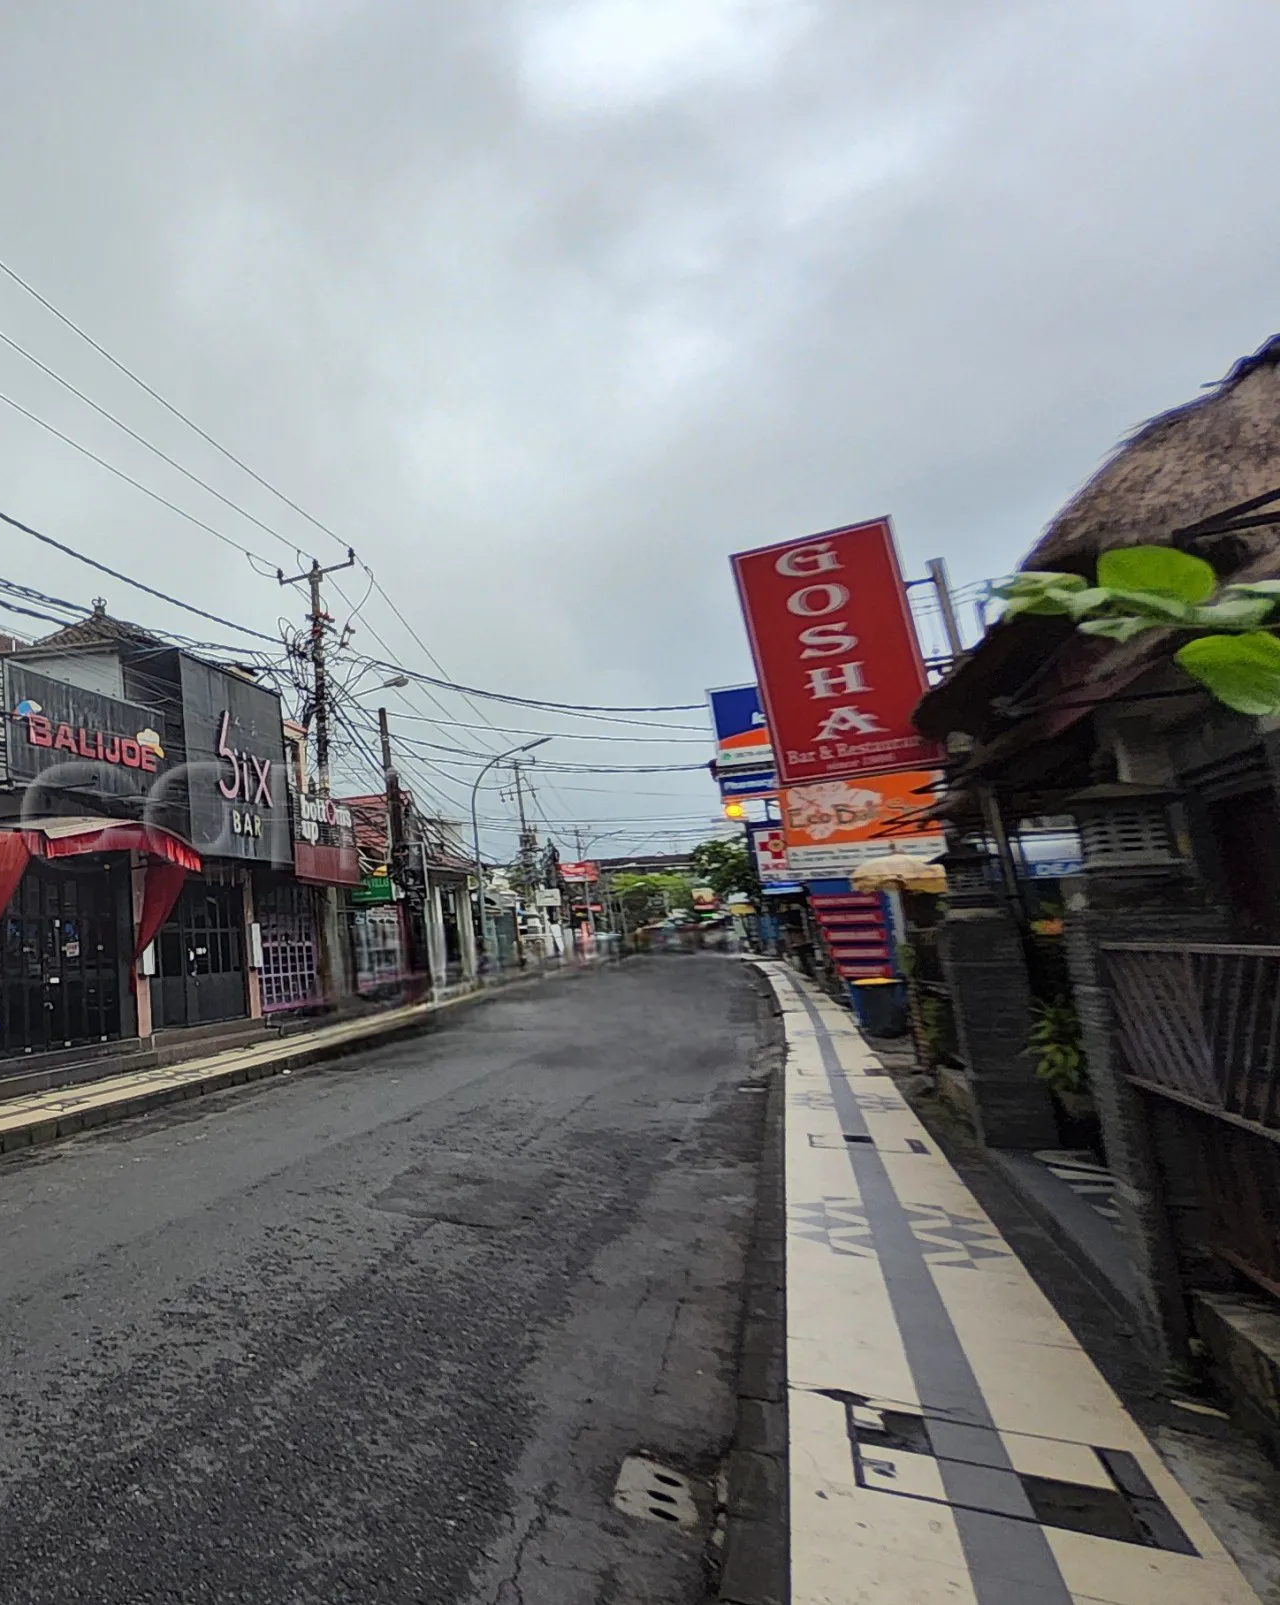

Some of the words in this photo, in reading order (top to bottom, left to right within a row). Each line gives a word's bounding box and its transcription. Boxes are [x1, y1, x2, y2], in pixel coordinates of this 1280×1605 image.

[775, 541, 891, 742] GOSHA
[28, 712, 158, 773] BALIJOE
[232, 809, 262, 838] BAR
[300, 820, 319, 846] up
